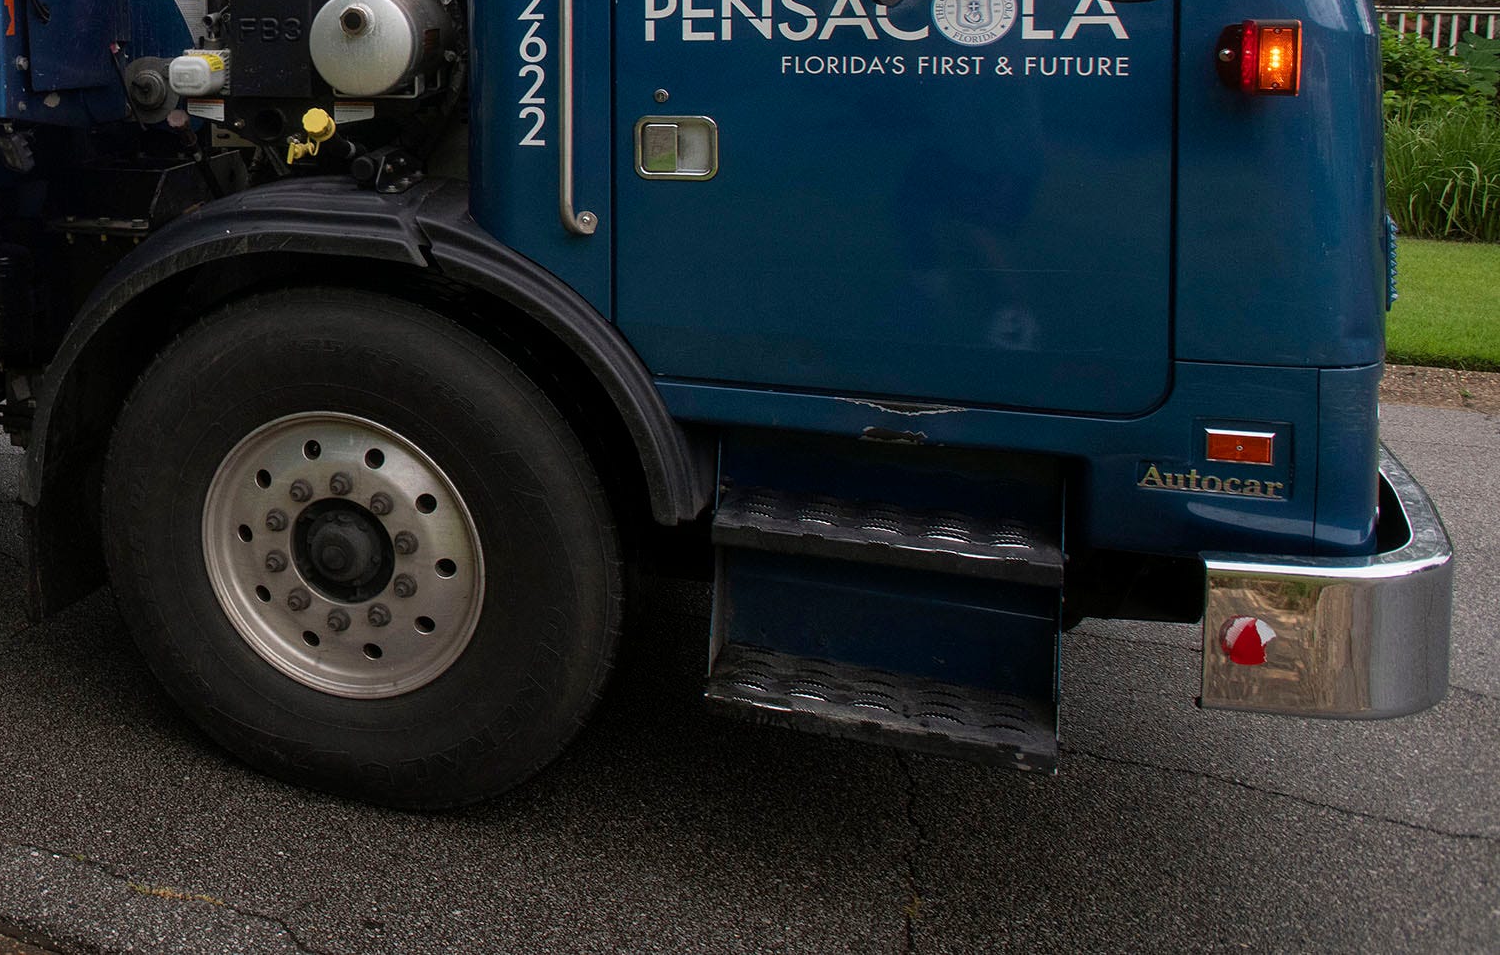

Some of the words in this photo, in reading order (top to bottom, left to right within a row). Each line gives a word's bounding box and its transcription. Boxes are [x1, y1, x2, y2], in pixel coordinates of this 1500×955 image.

[935, 4, 945, 22] THE
[238, 18, 301, 42] FB3
[952, 31, 997, 43] FLORIDA
[781, 55, 906, 76] FLORIDA'S
[918, 55, 984, 76] FIRST
[995, 56, 1014, 76] &
[1025, 56, 1130, 76] FUTURE
[1137, 464, 1284, 499] Autocar
